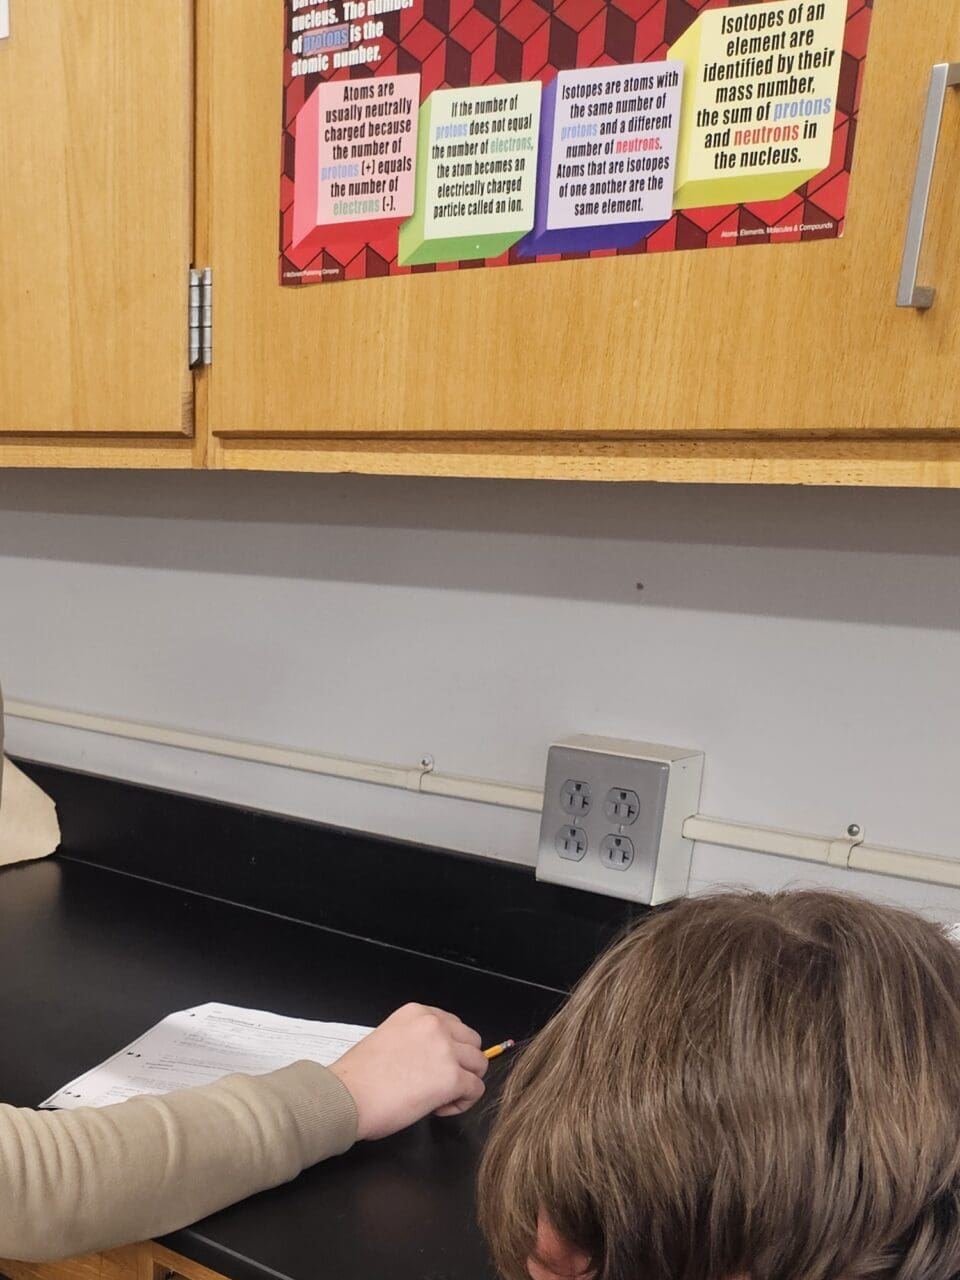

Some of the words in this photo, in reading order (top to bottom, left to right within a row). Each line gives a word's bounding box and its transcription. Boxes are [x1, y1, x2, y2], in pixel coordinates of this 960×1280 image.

[292, 8, 339, 32] nucleus.
[343, 2, 365, 20] The
[721, 9, 784, 35] Isotopes
[788, 3, 804, 25] of
[807, 3, 825, 22] an
[292, 35, 303, 55] of
[303, 28, 348, 53] protons
[350, 25, 361, 43] is
[363, 20, 384, 40] the
[726, 31, 786, 57] element
[790, 28, 814, 48] are
[291, 53, 329, 77] atomic
[333, 45, 381, 68] number.
[703, 55, 774, 82] identified
[777, 53, 795, 75] by
[798, 47, 835, 70] their
[343, 85, 374, 102] Atoms
[378, 82, 394, 97] are
[562, 82, 602, 100] Isotopes
[605, 80, 621, 94] are
[624, 76, 654, 92] atoms
[657, 71, 679, 88] with
[715, 83, 753, 104] mass
[757, 75, 815, 99] number,
[325, 104, 362, 123] usually
[365, 97, 412, 118] neutrally
[451, 102, 458, 118] If
[459, 101, 472, 116] the
[475, 97, 508, 115] number
[509, 94, 518, 111] of
[570, 103, 585, 119] the
[588, 102, 613, 117] same
[616, 96, 653, 114] number
[656, 93, 667, 109] of
[697, 108, 719, 127] the
[723, 107, 752, 125] sum
[756, 102, 771, 121] of
[773, 97, 831, 122] protons
[325, 122, 365, 142] charged
[368, 119, 411, 137] because
[436, 123, 468, 140] protons
[470, 120, 489, 136] does
[491, 118, 505, 133] not
[507, 113, 532, 133] equal
[561, 123, 597, 141] protons
[600, 119, 618, 135] and
[620, 120, 625, 133] a
[628, 114, 672, 132] different
[704, 128, 731, 149] and
[734, 124, 800, 146] neutrons
[803, 120, 817, 140] in
[333, 144, 348, 160] the
[351, 140, 389, 158] number
[392, 137, 402, 154] of
[432, 144, 444, 159] the
[447, 141, 478, 158] number
[480, 139, 489, 154] of
[566, 141, 602, 159] number
[605, 139, 614, 155] of
[616, 137, 662, 154] neutrons.
[714, 151, 736, 170] the
[740, 146, 801, 168] nucleus.
[321, 164, 359, 181] protons
[378, 156, 412, 174] equals
[437, 163, 449, 179] the
[452, 162, 472, 177] atom
[474, 160, 513, 175] becomes
[515, 158, 525, 171] an
[556, 163, 584, 179] Atoms
[587, 161, 606, 177] that
[608, 160, 624, 174] are
[627, 156, 669, 172] isotopes
[331, 182, 345, 197] the
[349, 178, 386, 196] number
[389, 175, 398, 192] of
[438, 180, 485, 198] electrically
[487, 176, 522, 194] charged
[559, 182, 569, 198] of
[570, 182, 587, 196] one
[590, 179, 627, 195] another
[629, 178, 645, 192] are
[647, 175, 664, 191] the
[333, 199, 380, 215] electrons
[433, 201, 465, 220] particle
[468, 199, 494, 215] called
[496, 200, 506, 213] an
[508, 197, 523, 212] ion.
[574, 202, 599, 216] same
[602, 197, 644, 214] element.
[799, 222, 833, 231] Compounds
